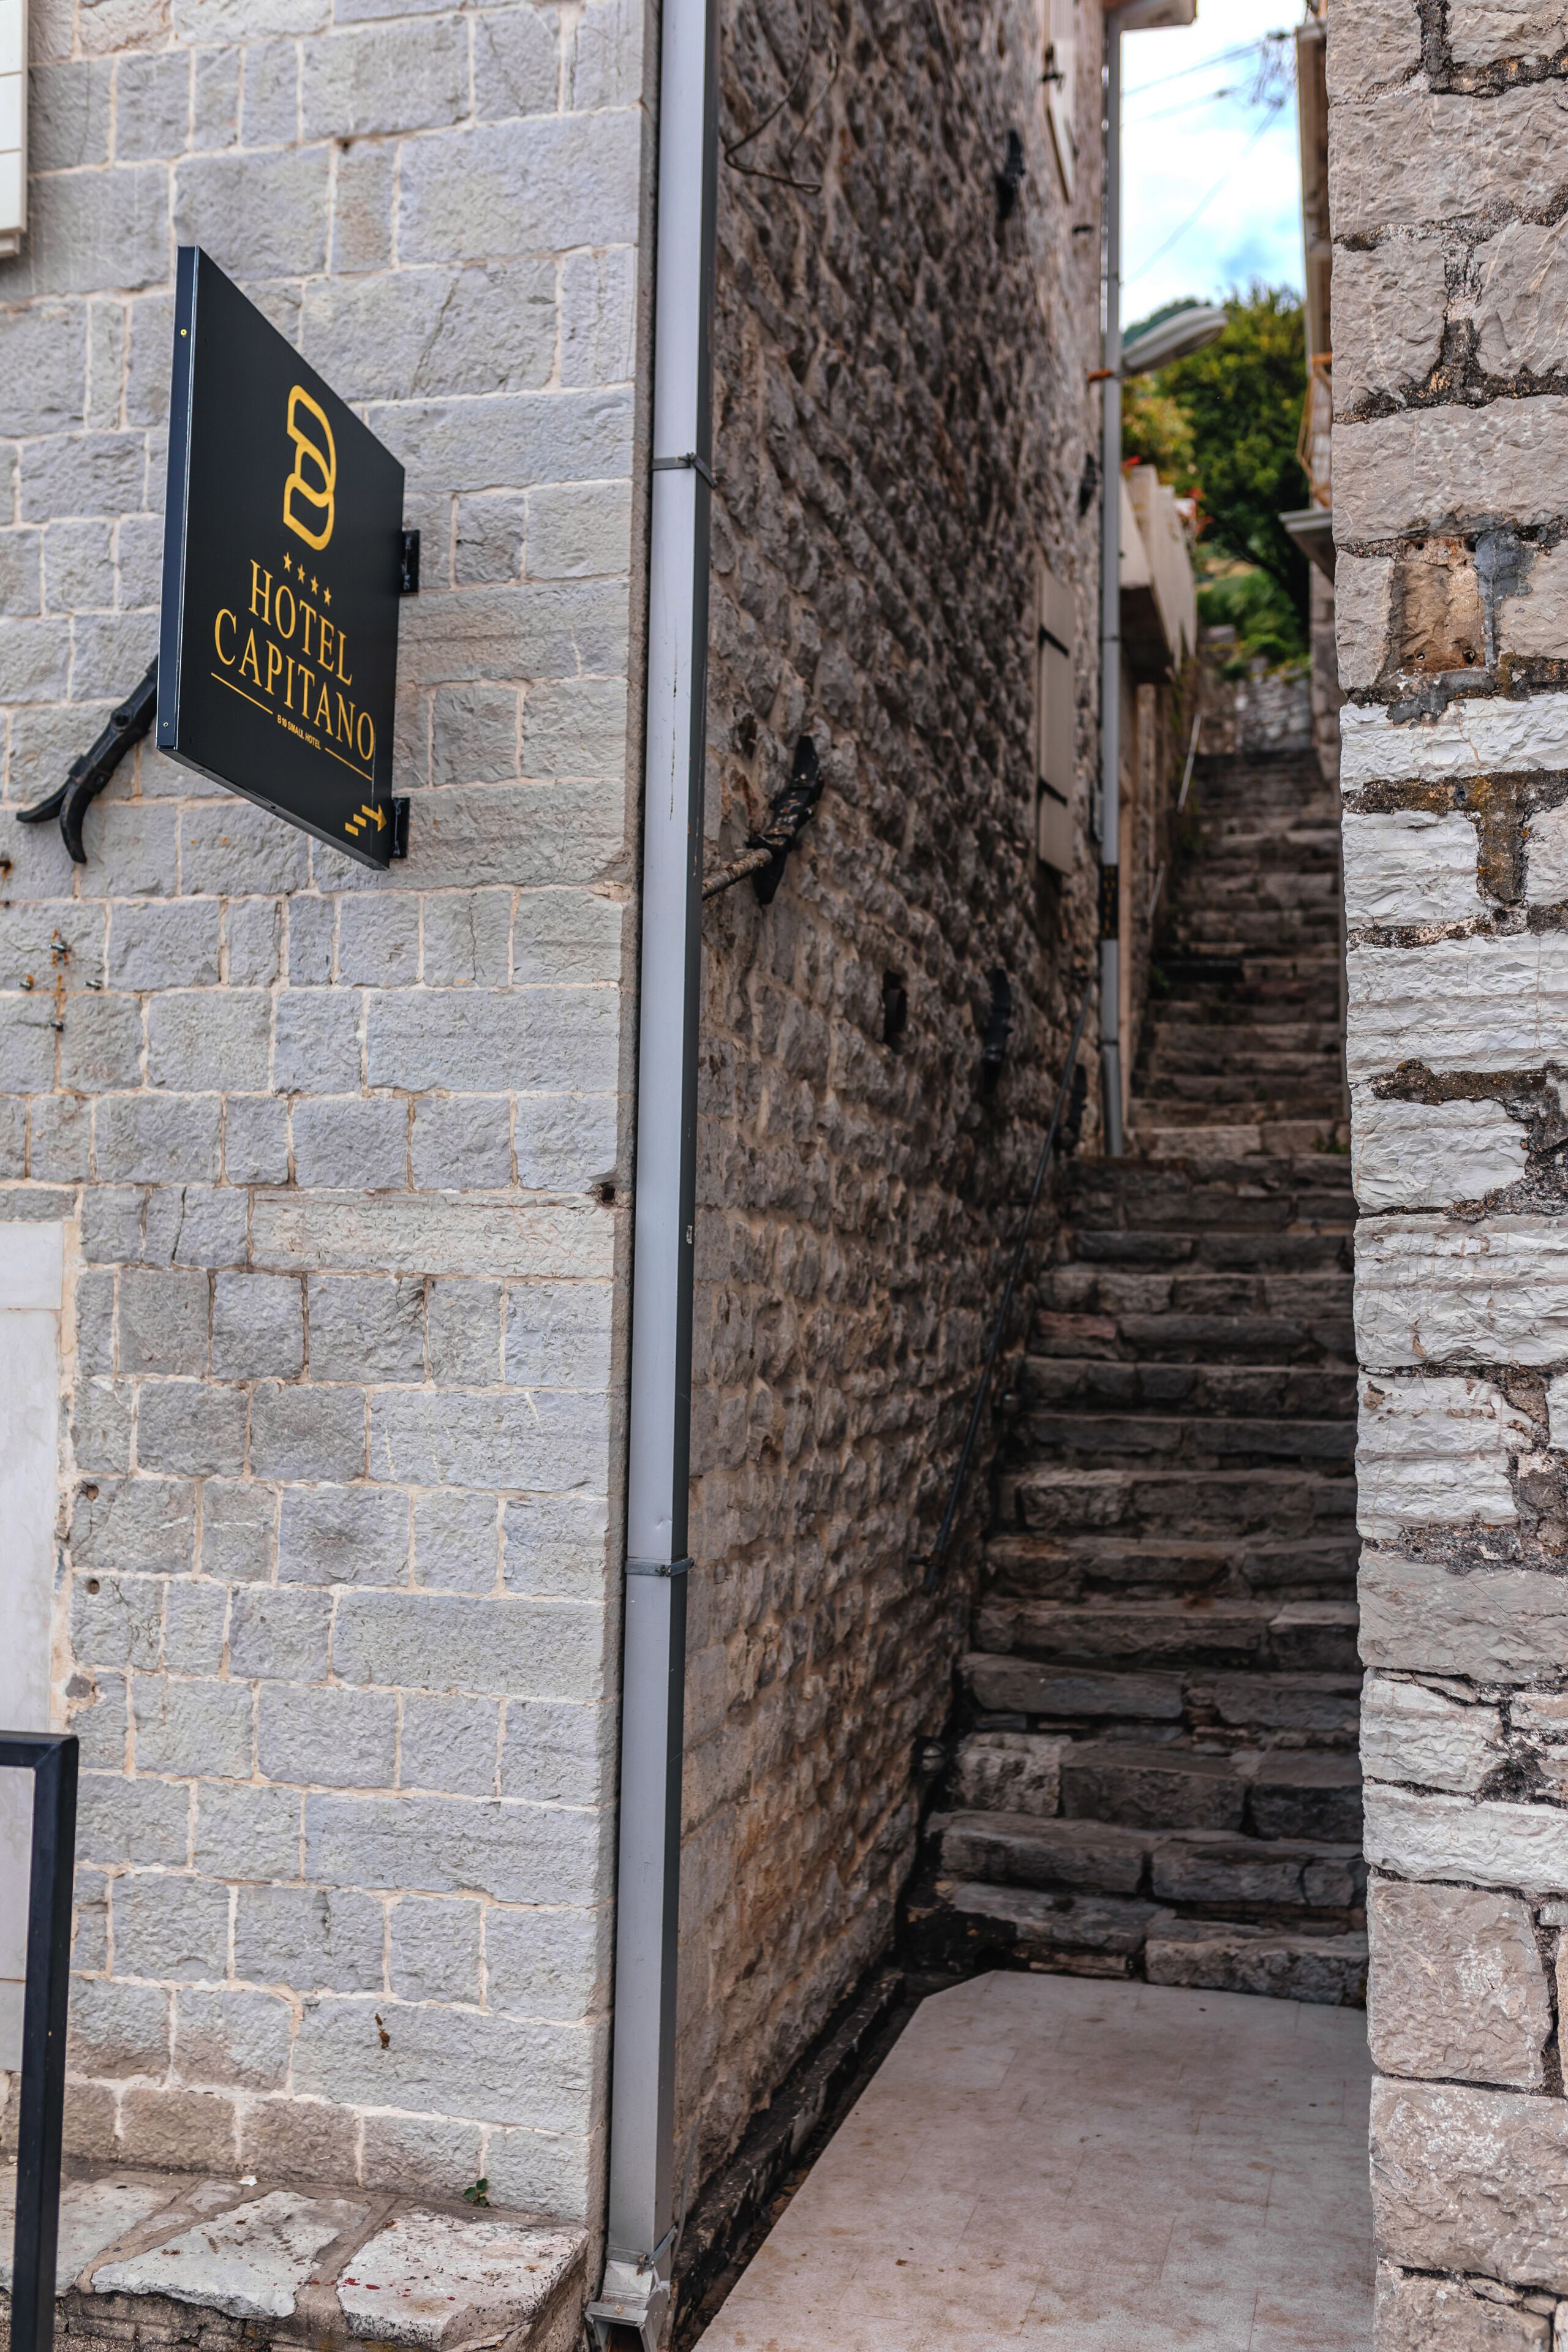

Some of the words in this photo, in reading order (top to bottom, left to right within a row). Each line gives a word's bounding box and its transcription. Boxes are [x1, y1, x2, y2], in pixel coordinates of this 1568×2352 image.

[214, 608, 375, 761] CAPITANO
[248, 559, 353, 686] HOTEL
[287, 721, 304, 739] SMALL
[305, 733, 322, 750] HOTEL
